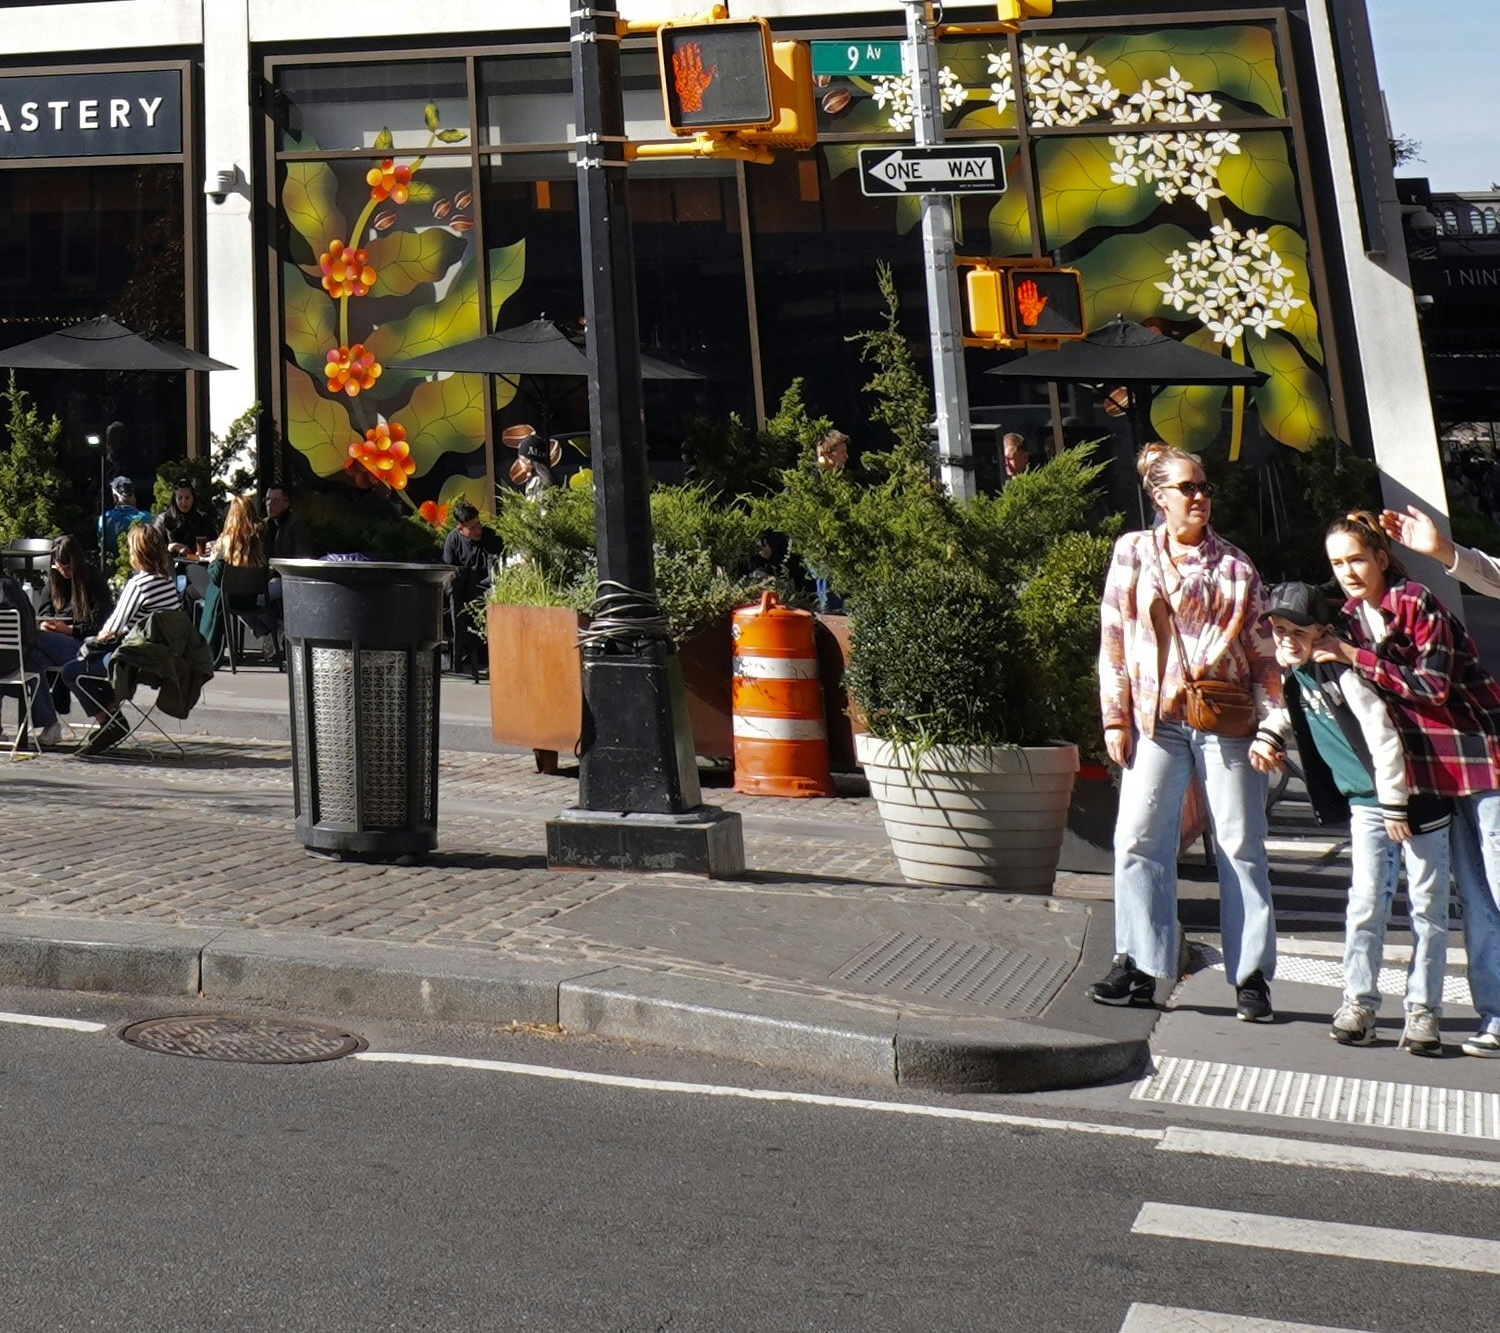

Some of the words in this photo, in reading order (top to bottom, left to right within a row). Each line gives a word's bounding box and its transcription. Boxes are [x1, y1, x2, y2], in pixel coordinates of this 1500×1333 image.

[847, 46, 859, 70] 9
[885, 162, 922, 180] ONE
[948, 160, 986, 178] WAY
[1444, 269, 1451, 286] 1
